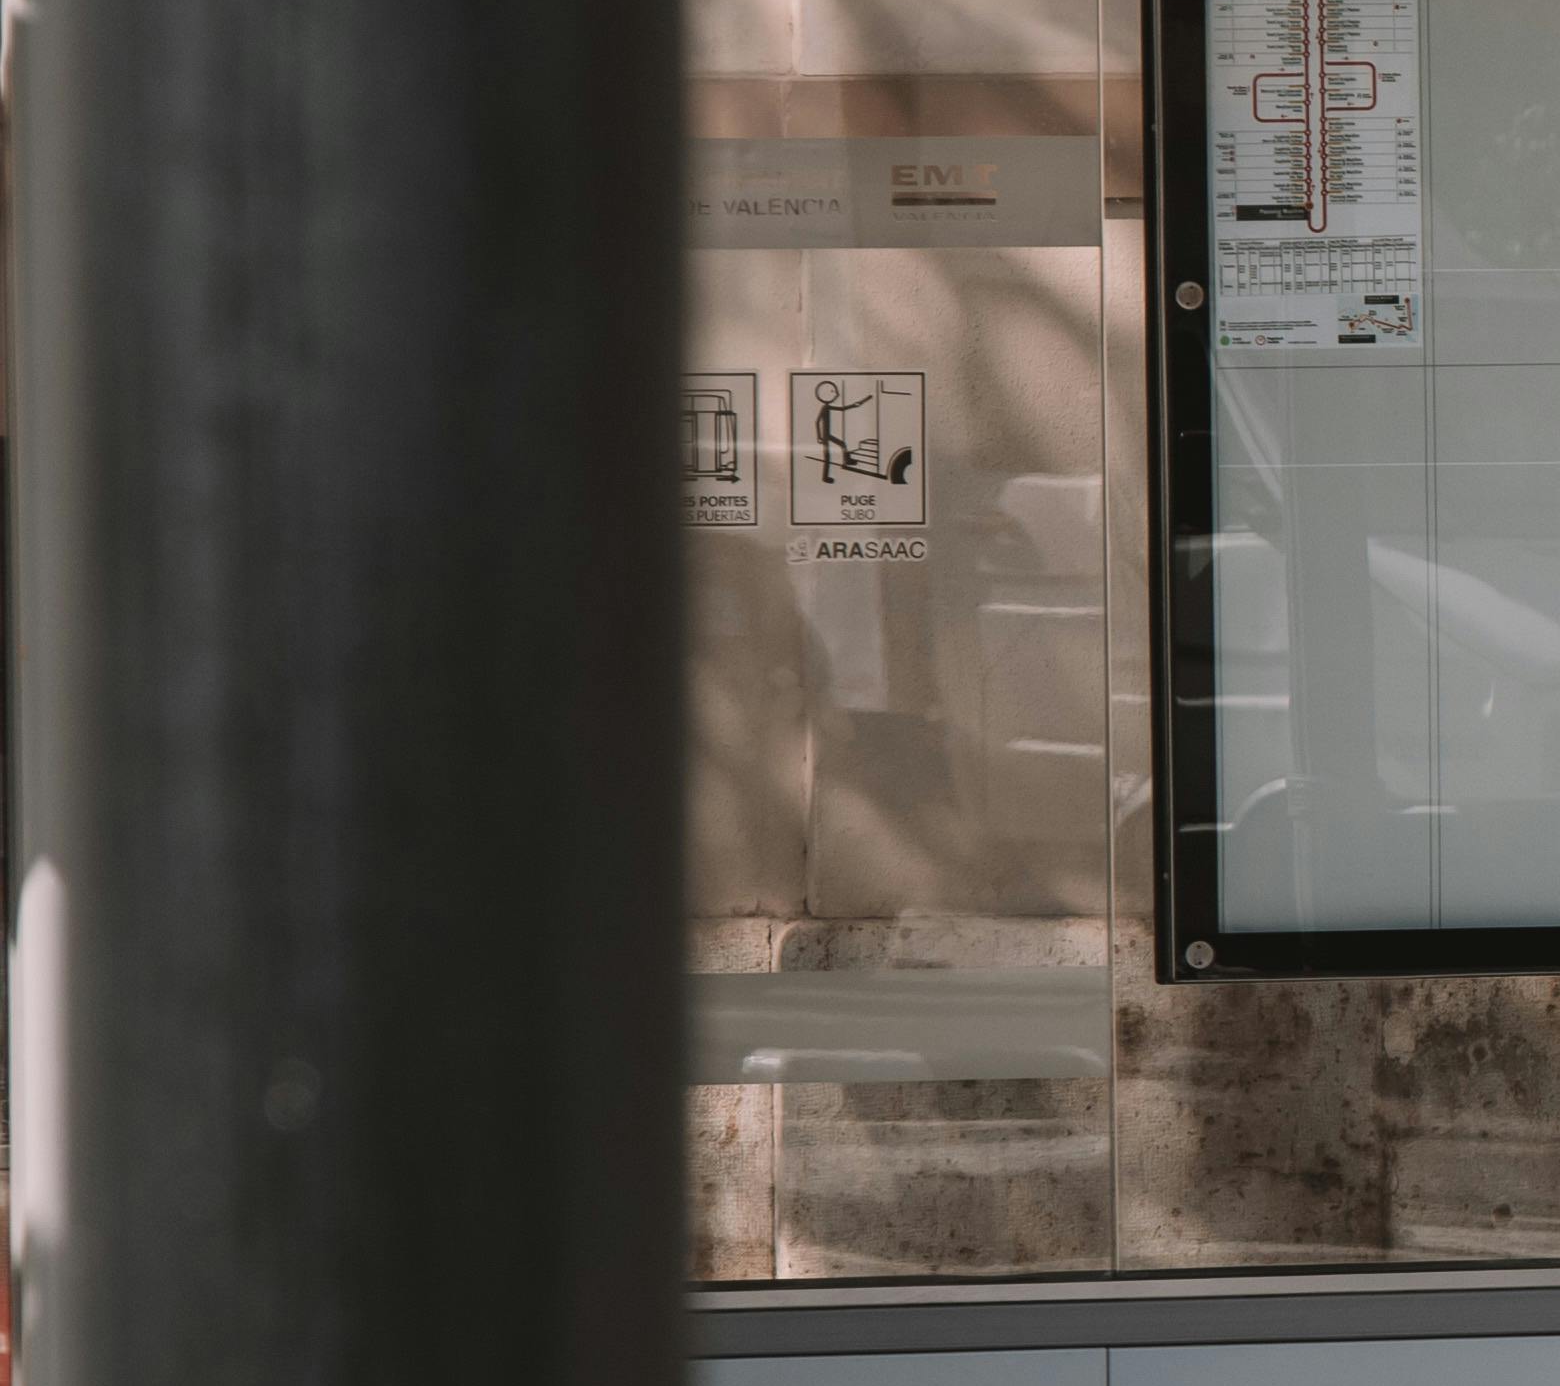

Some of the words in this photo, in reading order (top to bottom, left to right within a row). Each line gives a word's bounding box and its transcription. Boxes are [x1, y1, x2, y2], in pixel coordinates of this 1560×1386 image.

[890, 165, 997, 187] EMT
[723, 198, 841, 215] VALENCIA
[700, 496, 748, 507] PORTES
[841, 495, 876, 506] PUGE
[697, 510, 750, 521] PUERTAS
[841, 509, 875, 520] SUBO
[816, 541, 925, 559] ARASAAC
